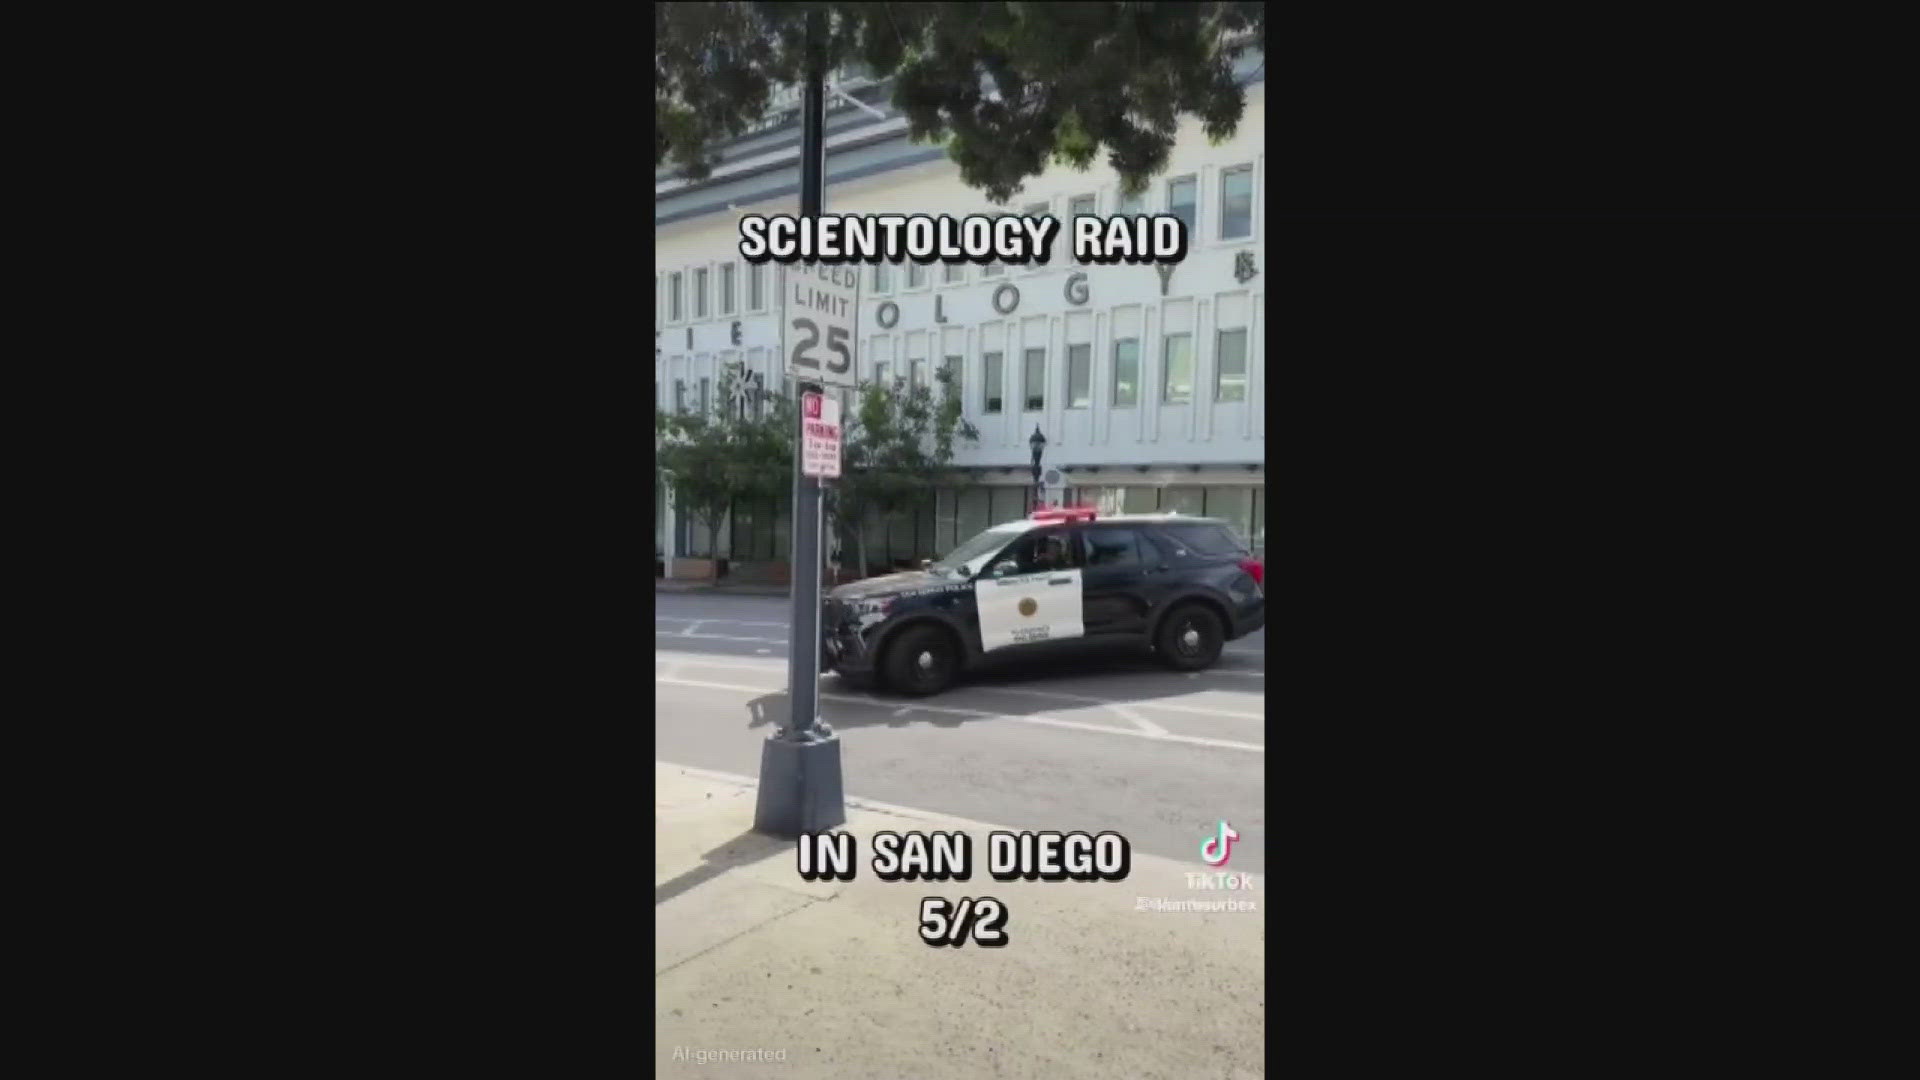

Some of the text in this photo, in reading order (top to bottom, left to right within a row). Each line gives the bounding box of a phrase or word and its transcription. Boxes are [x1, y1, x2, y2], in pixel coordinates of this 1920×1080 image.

[795, 282, 849, 318] LIMIT
[791, 317, 851, 374] 25
[806, 396, 819, 415] NO
[806, 423, 839, 442] PARKING
